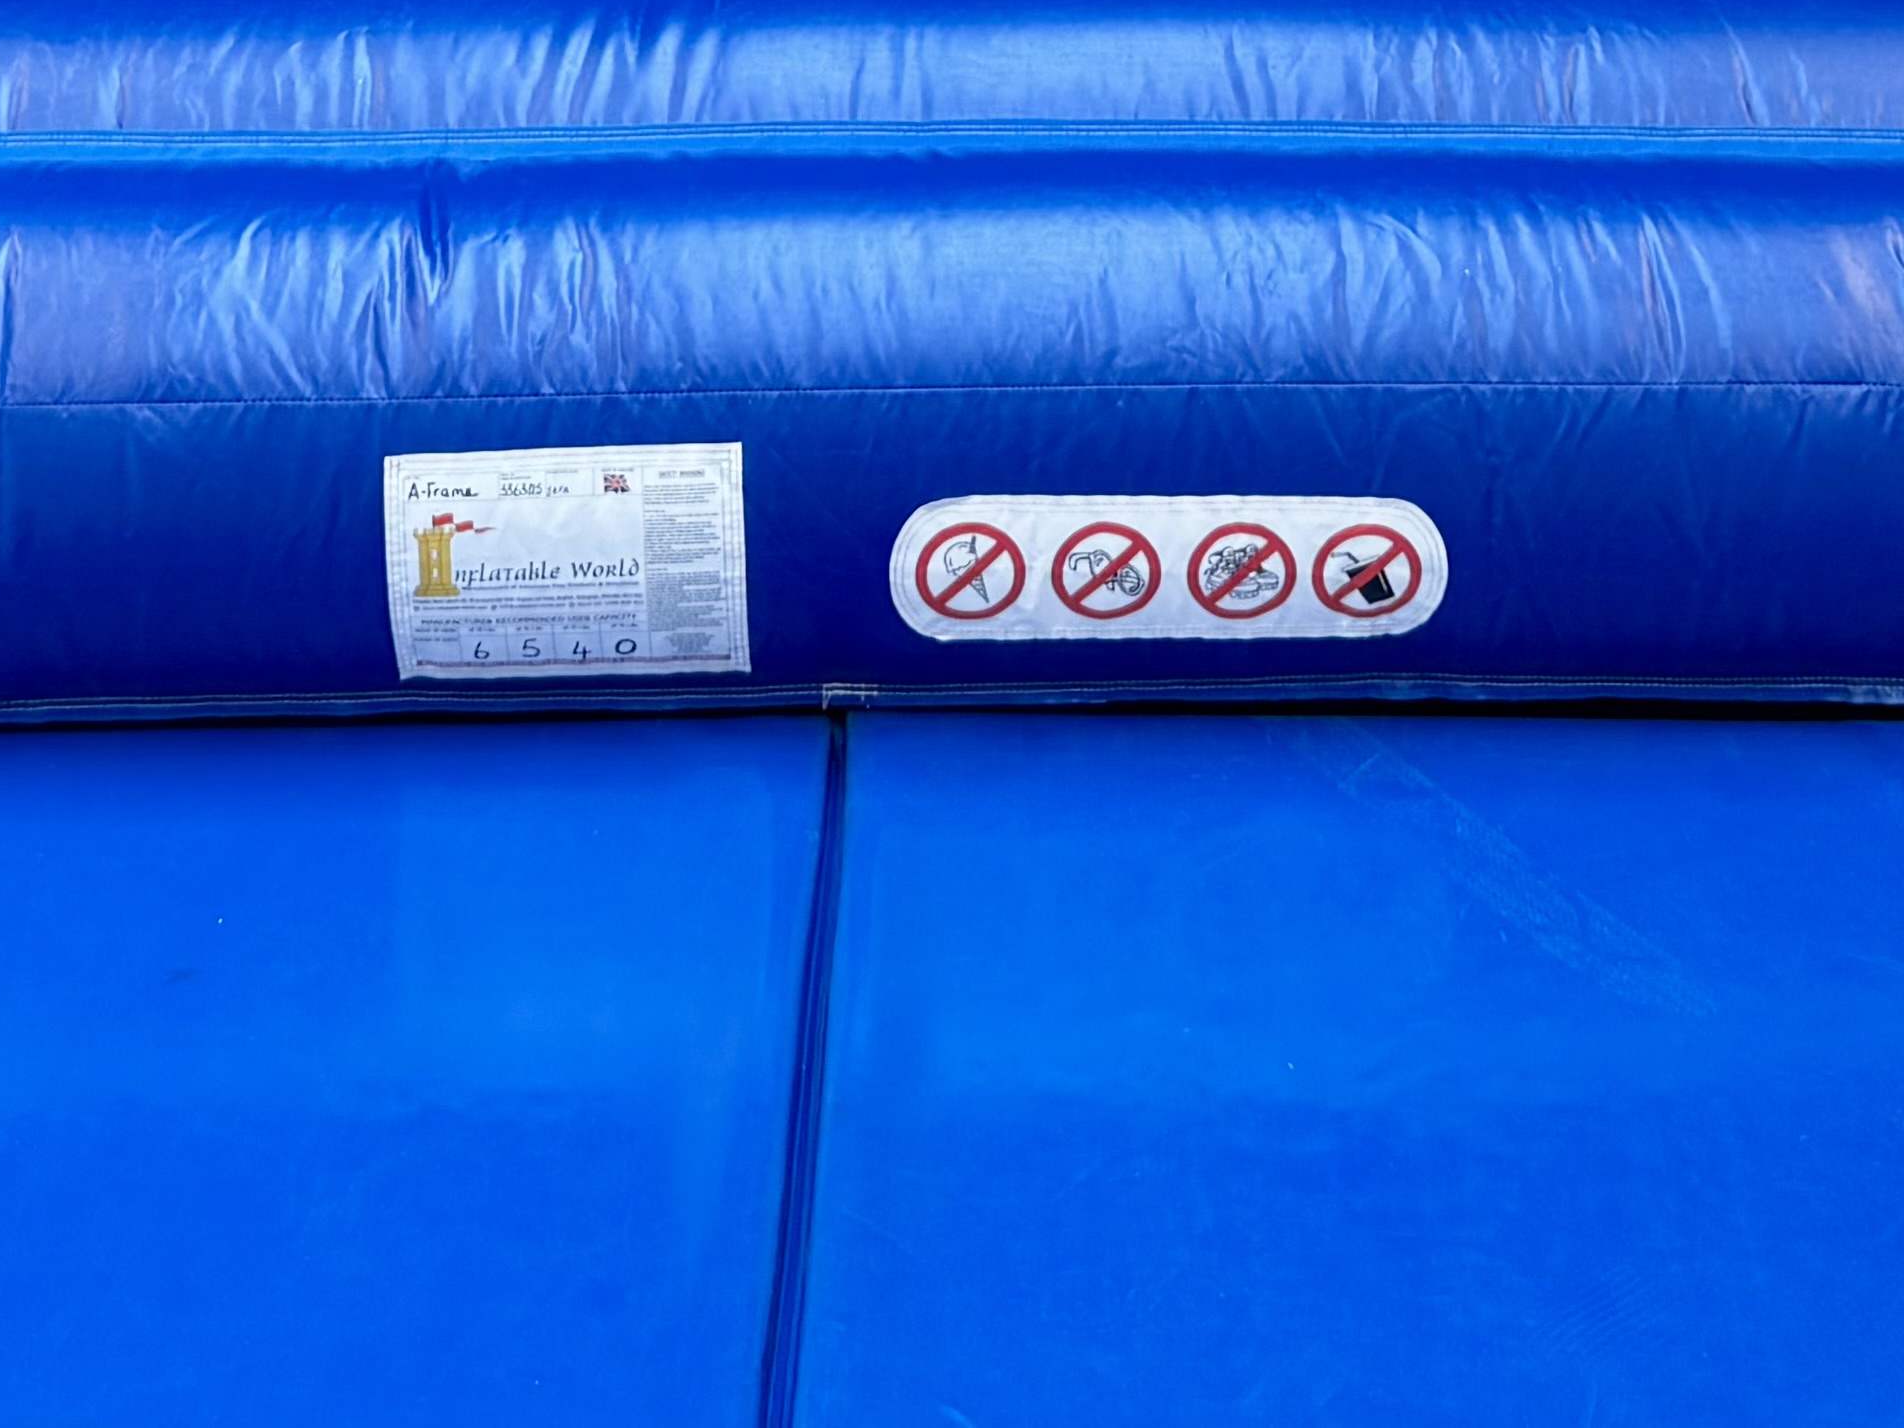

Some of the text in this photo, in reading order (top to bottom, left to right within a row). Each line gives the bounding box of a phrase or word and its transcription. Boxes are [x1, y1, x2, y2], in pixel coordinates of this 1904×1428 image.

[408, 482, 479, 500] A-Frame
[474, 642, 490, 661] 6
[522, 638, 541, 658] 5
[573, 641, 592, 662] 4
[615, 638, 637, 655] 0
